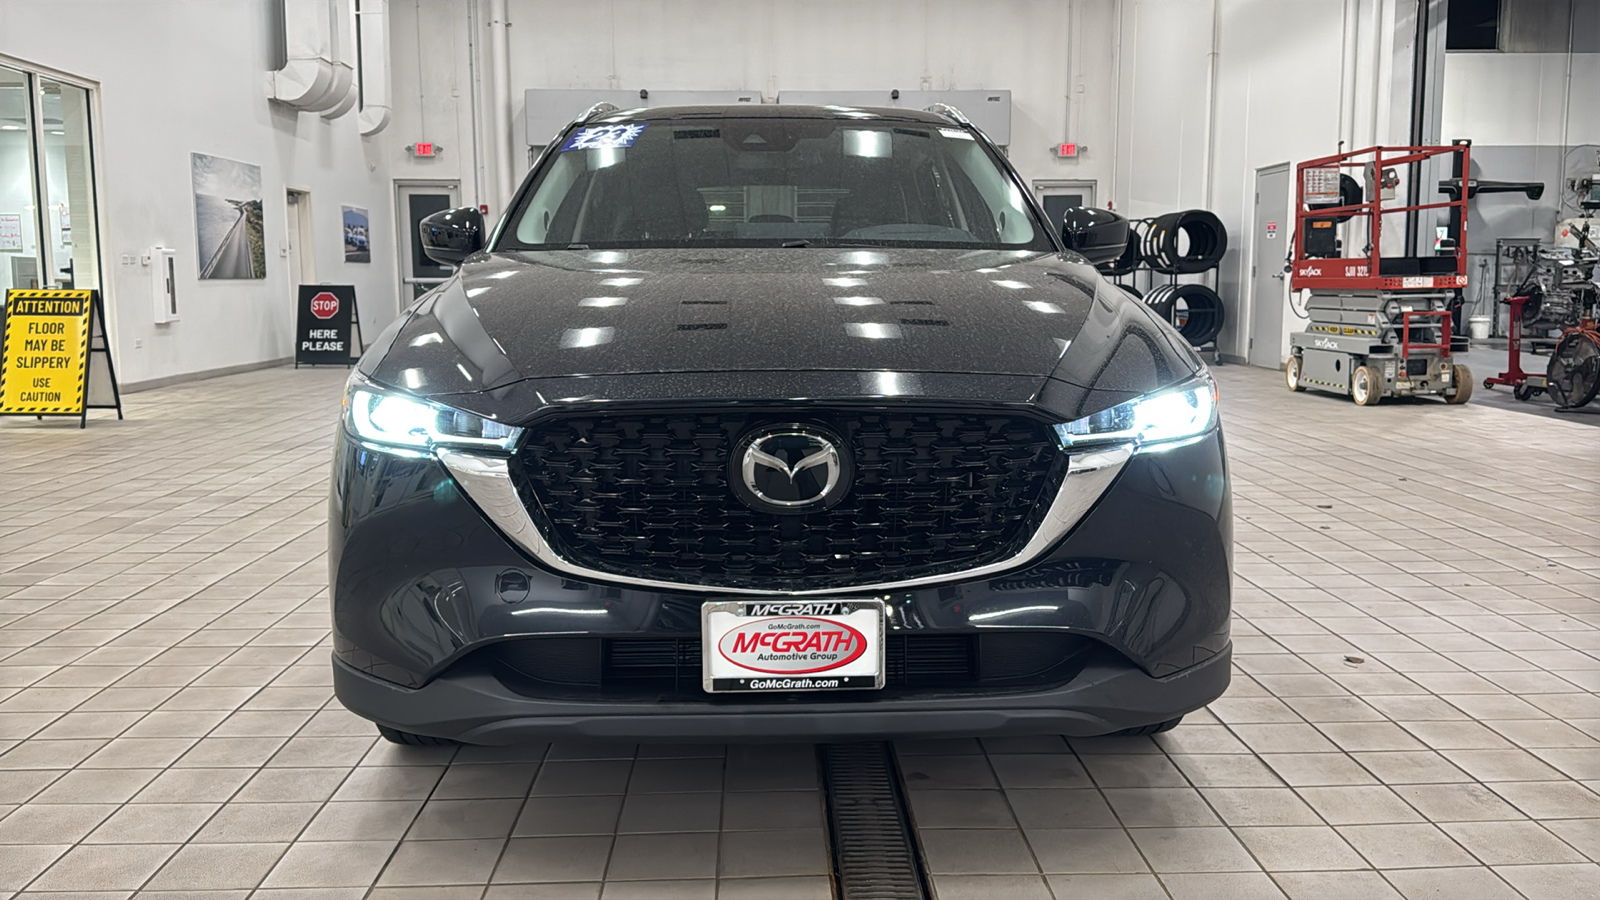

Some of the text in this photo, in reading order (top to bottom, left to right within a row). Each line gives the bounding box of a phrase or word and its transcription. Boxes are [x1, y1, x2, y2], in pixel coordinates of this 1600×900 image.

[16, 300, 80, 313] ATTENTION
[313, 301, 337, 311] STOP
[28, 322, 65, 334] FLOOR
[309, 329, 338, 339] HERE
[24, 339, 66, 351] MAY BE
[302, 341, 344, 351] PLEASE
[16, 356, 71, 369] SLIPPERY
[33, 378, 51, 388] USE
[20, 391, 61, 402] CAUTION
[767, 623, 821, 631] GoMcGrath.com
[757, 652, 838, 662] Automotive Group
[750, 679, 839, 689] GoMcGrath.com
